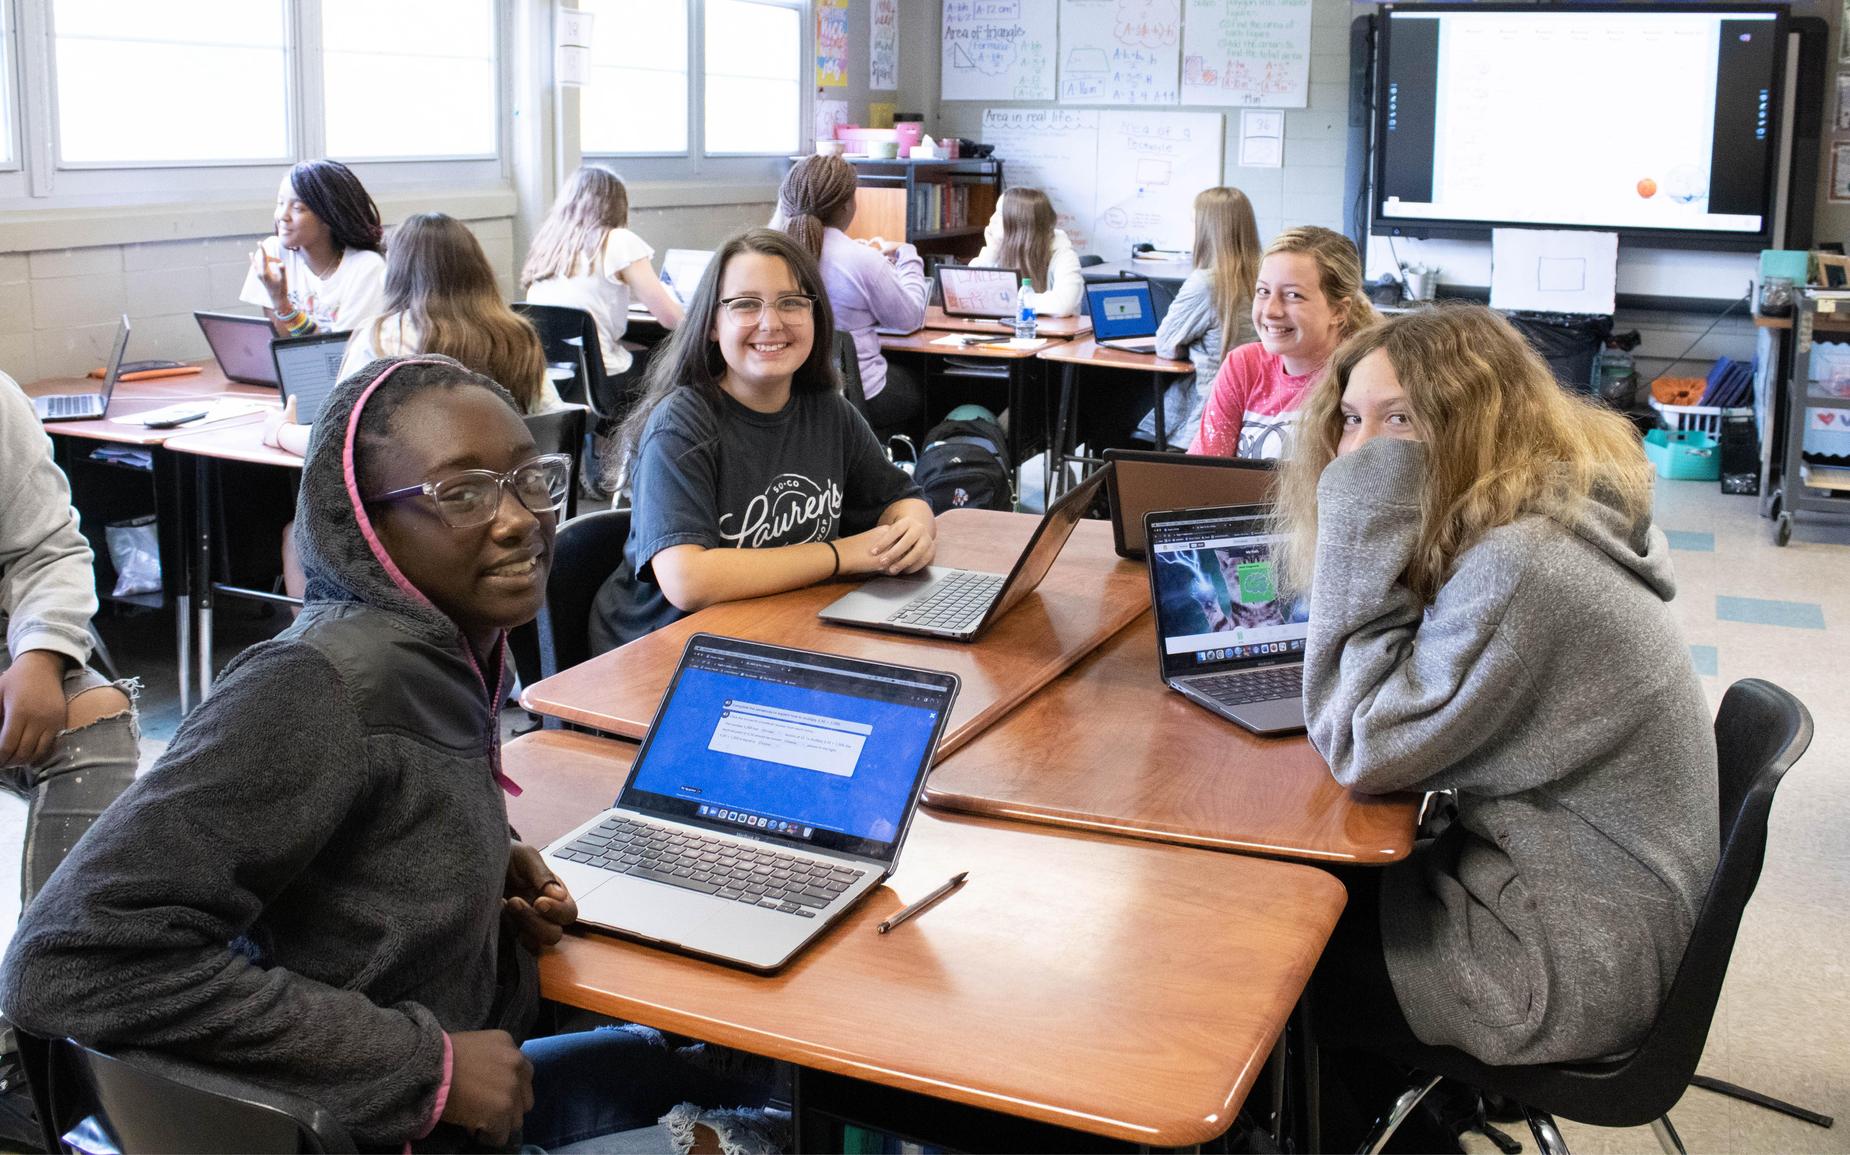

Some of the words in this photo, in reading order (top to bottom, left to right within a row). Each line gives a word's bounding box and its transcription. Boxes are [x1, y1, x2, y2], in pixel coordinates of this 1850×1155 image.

[944, 25, 968, 40] Area
[971, 25, 982, 40] of
[985, 109, 1008, 122] Area
[1012, 111, 1022, 122] in
[1026, 111, 1047, 122] real
[719, 479, 844, 549] Lauren's
[815, 518, 828, 542] HOP
